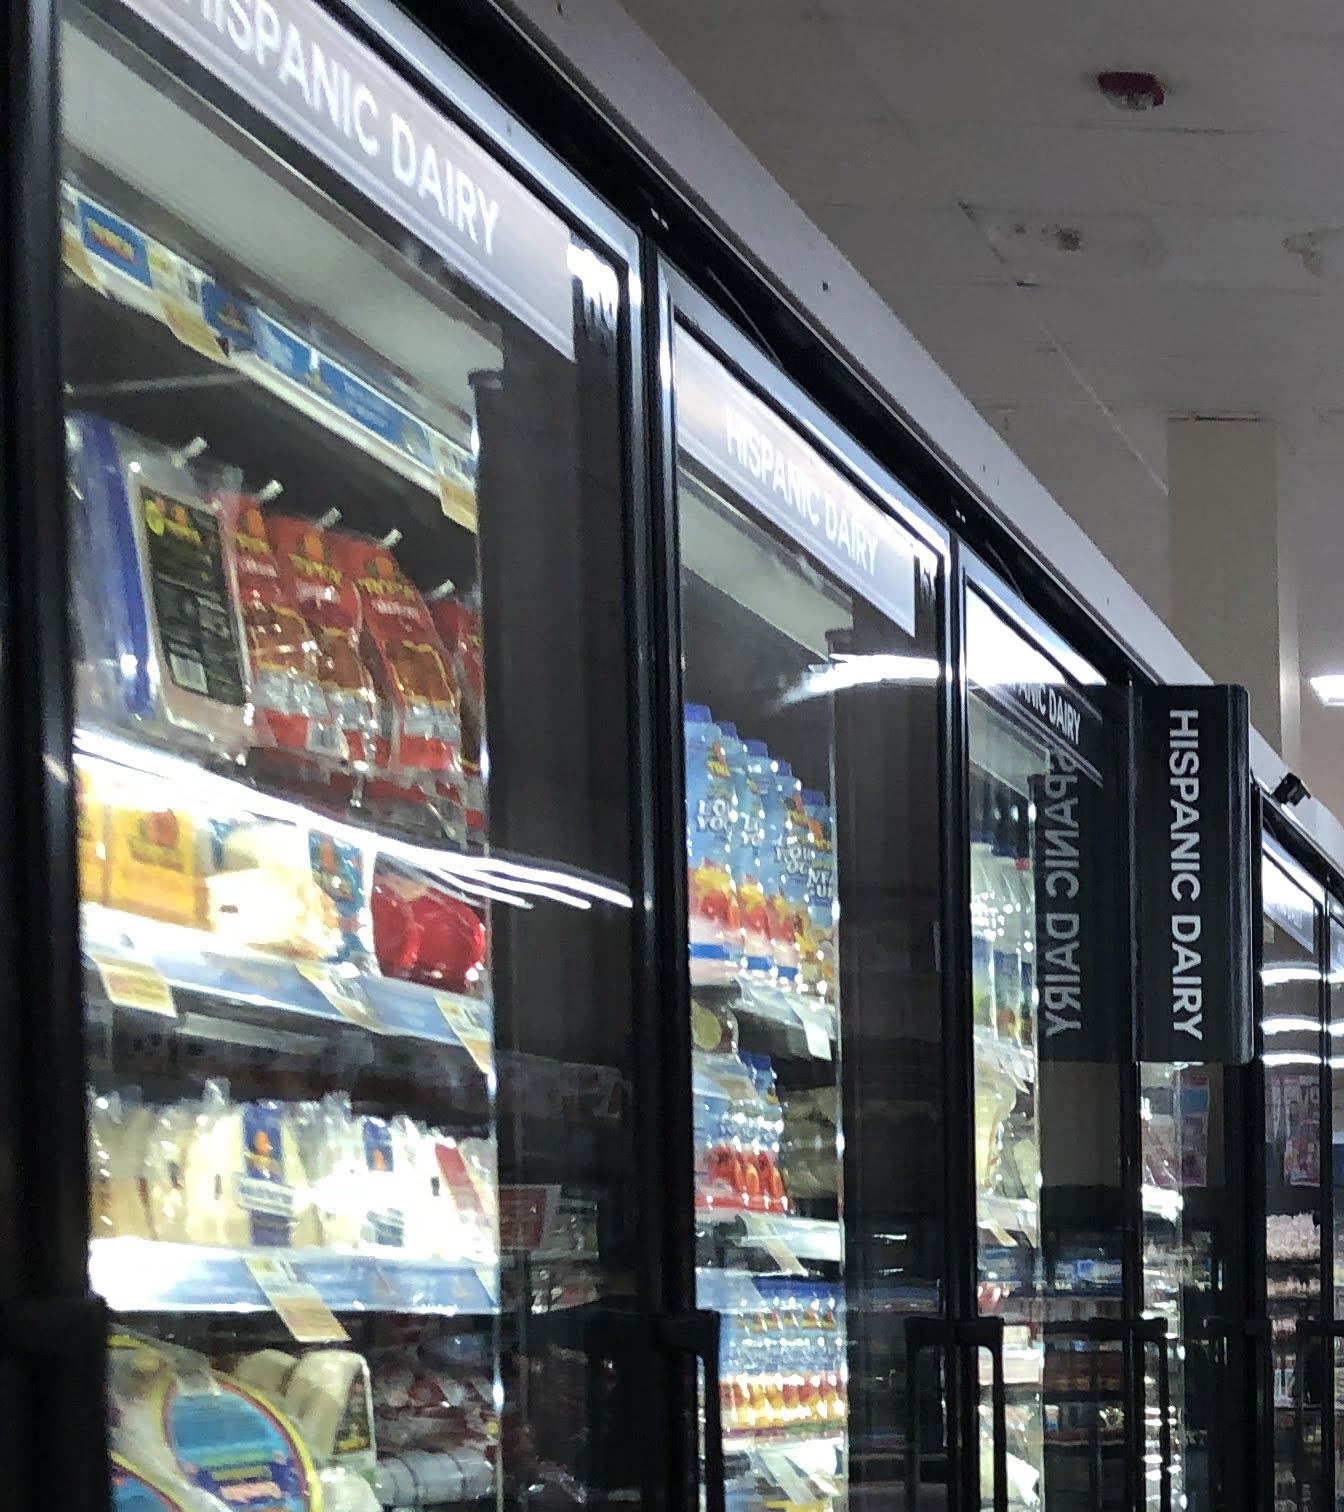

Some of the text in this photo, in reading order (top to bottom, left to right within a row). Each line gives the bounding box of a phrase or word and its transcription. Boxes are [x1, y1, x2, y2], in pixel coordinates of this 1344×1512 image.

[391, 112, 500, 257] DAIRY
[825, 498, 878, 577] DAIRY
[1048, 687, 1081, 746] DAIRY
[1169, 709, 1203, 1041] HISPANIC DAIRY
